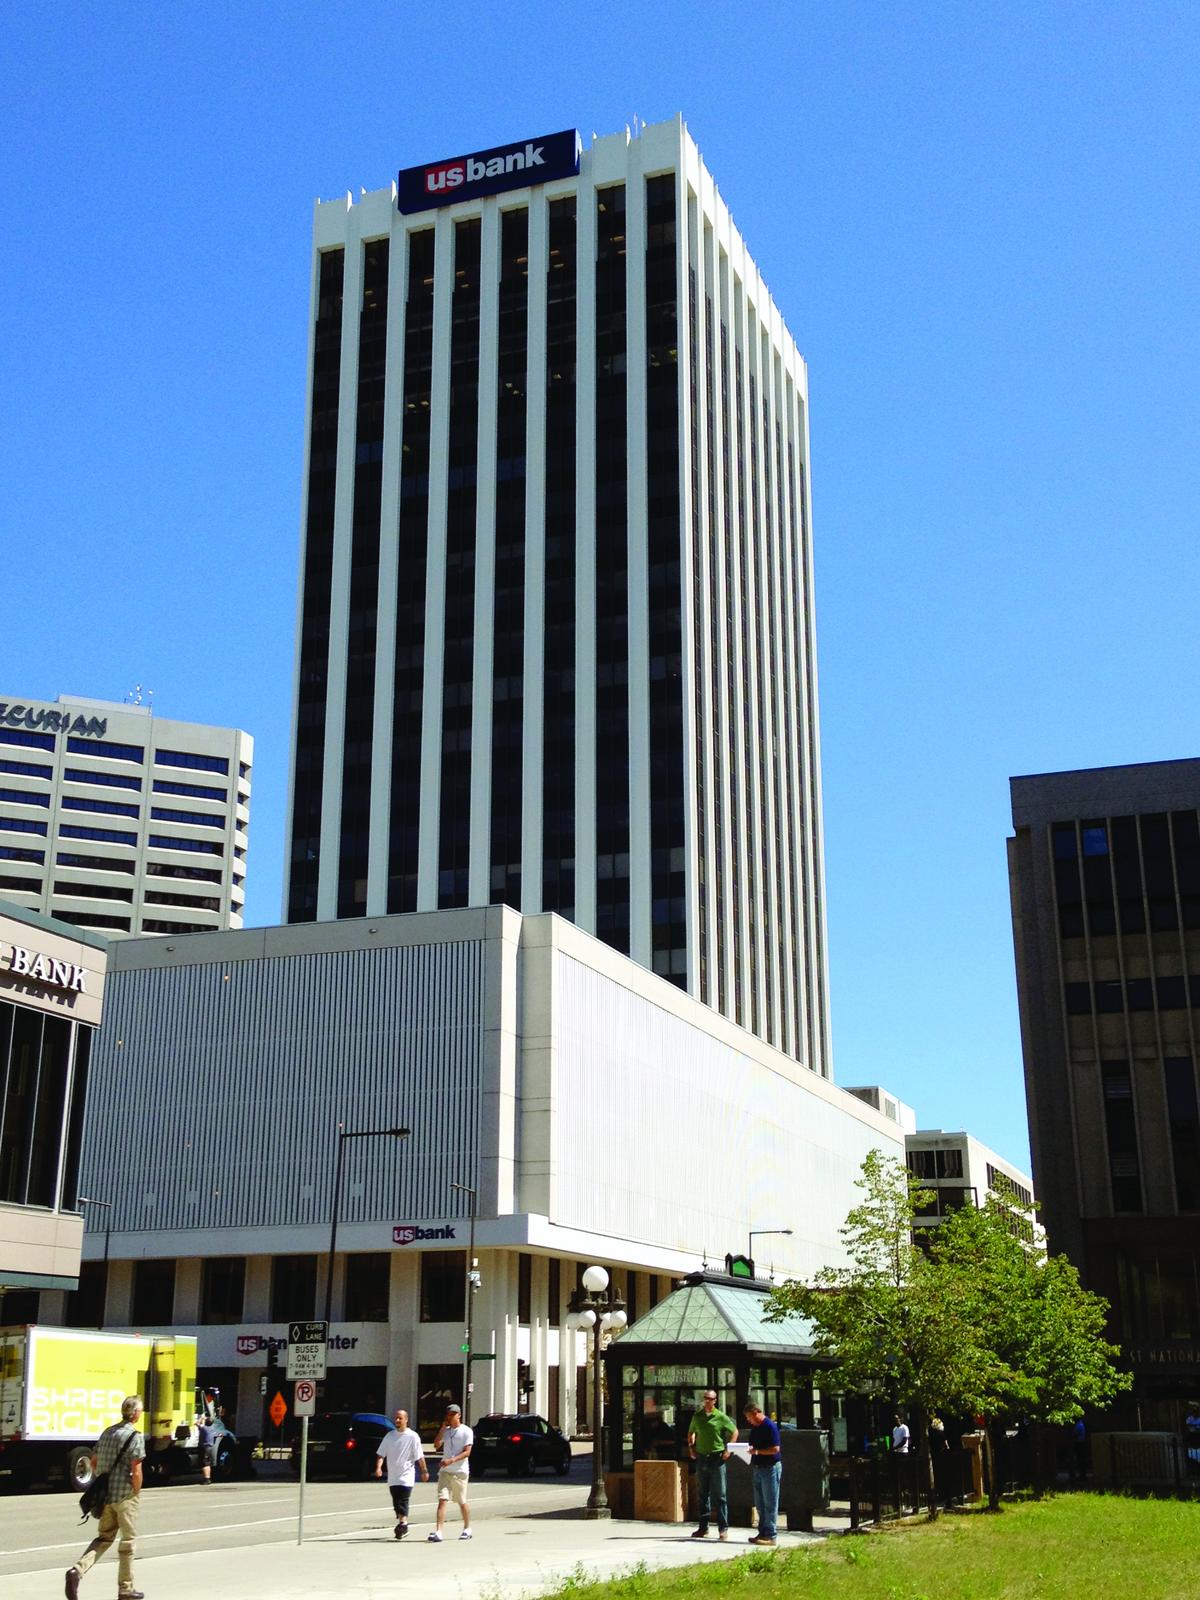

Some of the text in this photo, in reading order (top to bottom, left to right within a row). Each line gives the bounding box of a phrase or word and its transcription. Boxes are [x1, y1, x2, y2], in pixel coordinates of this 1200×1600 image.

[10, 945, 89, 993] BANK
[295, 1345, 319, 1354] BUSES
[327, 1334, 358, 1350] nter
[296, 1354, 317, 1362] ONLY
[31, 1387, 126, 1410] SHRED
